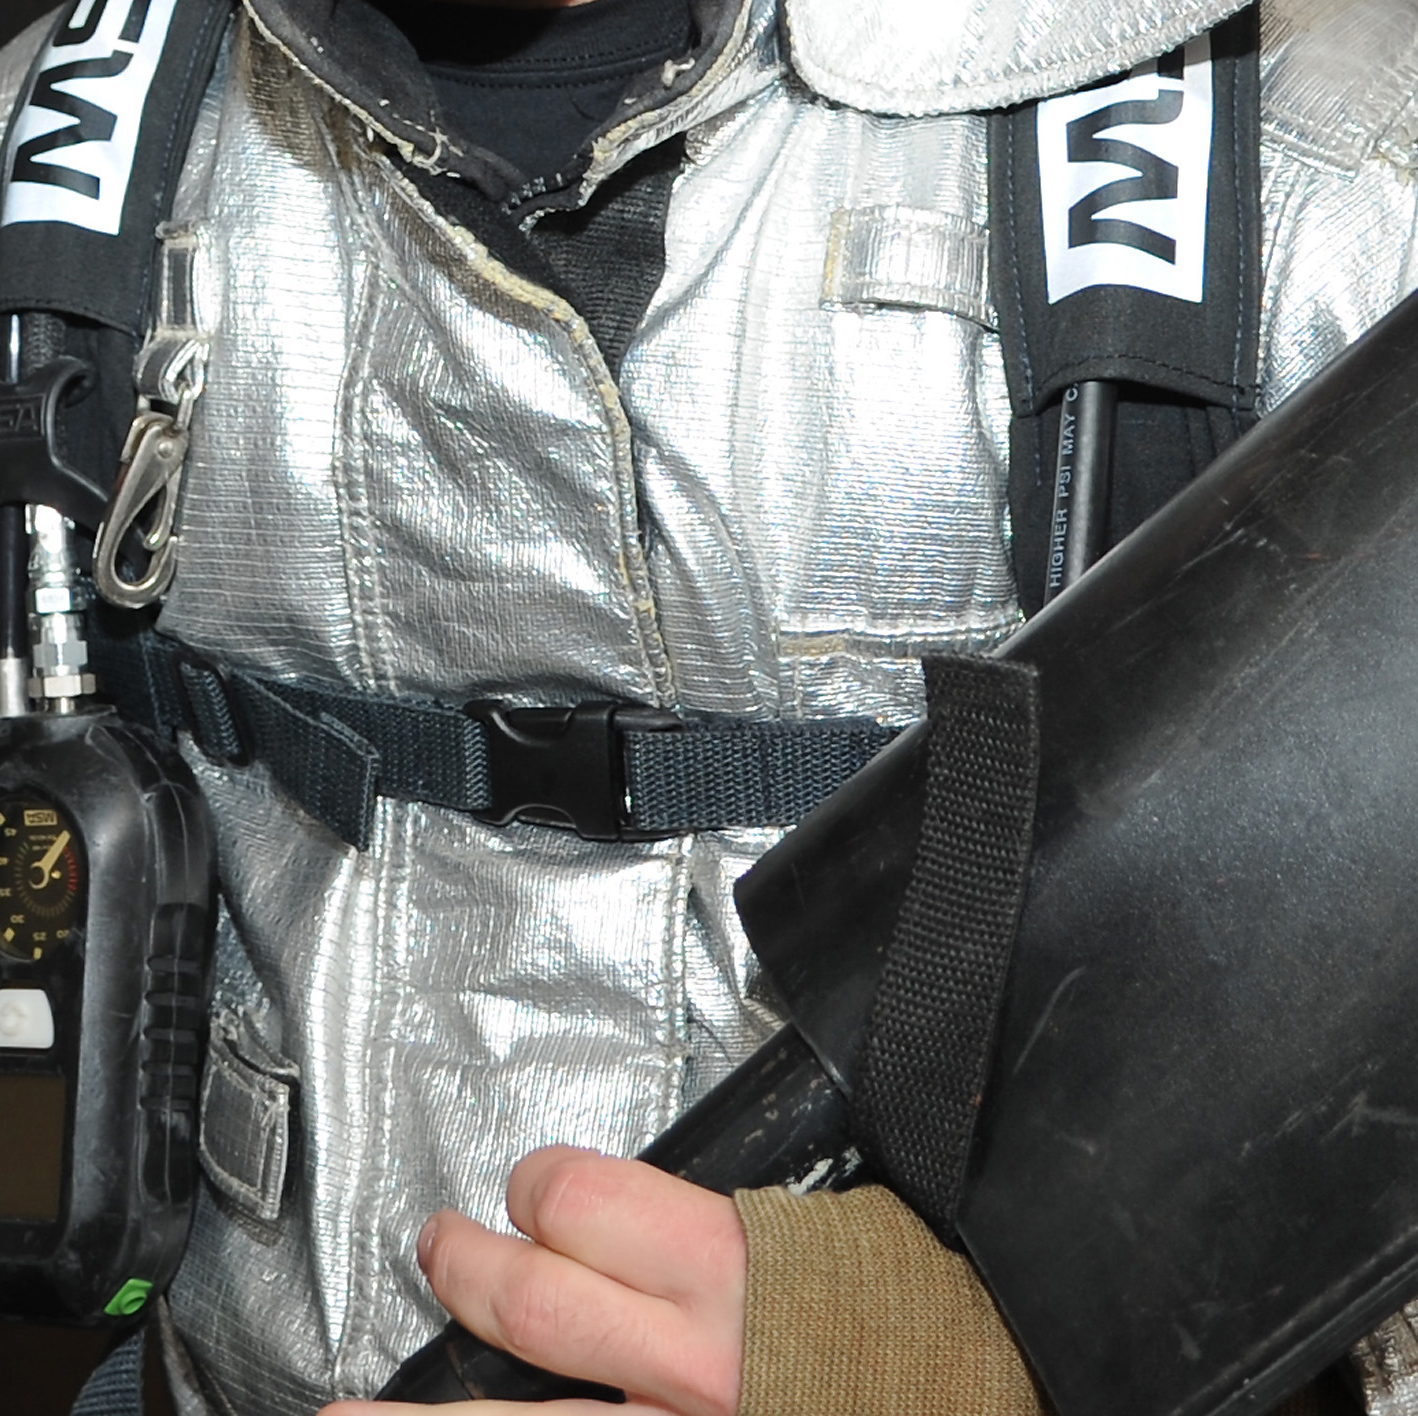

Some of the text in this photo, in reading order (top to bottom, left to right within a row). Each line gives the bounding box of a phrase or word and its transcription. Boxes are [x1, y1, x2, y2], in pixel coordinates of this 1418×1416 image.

[1061, 412, 1076, 456] MAY
[1058, 465, 1072, 498] PSI
[1049, 507, 1069, 588] HIGHER
[4, 827, 17, 837] 45
[10, 914, 25, 924] 30
[33, 931, 46, 941] 25
